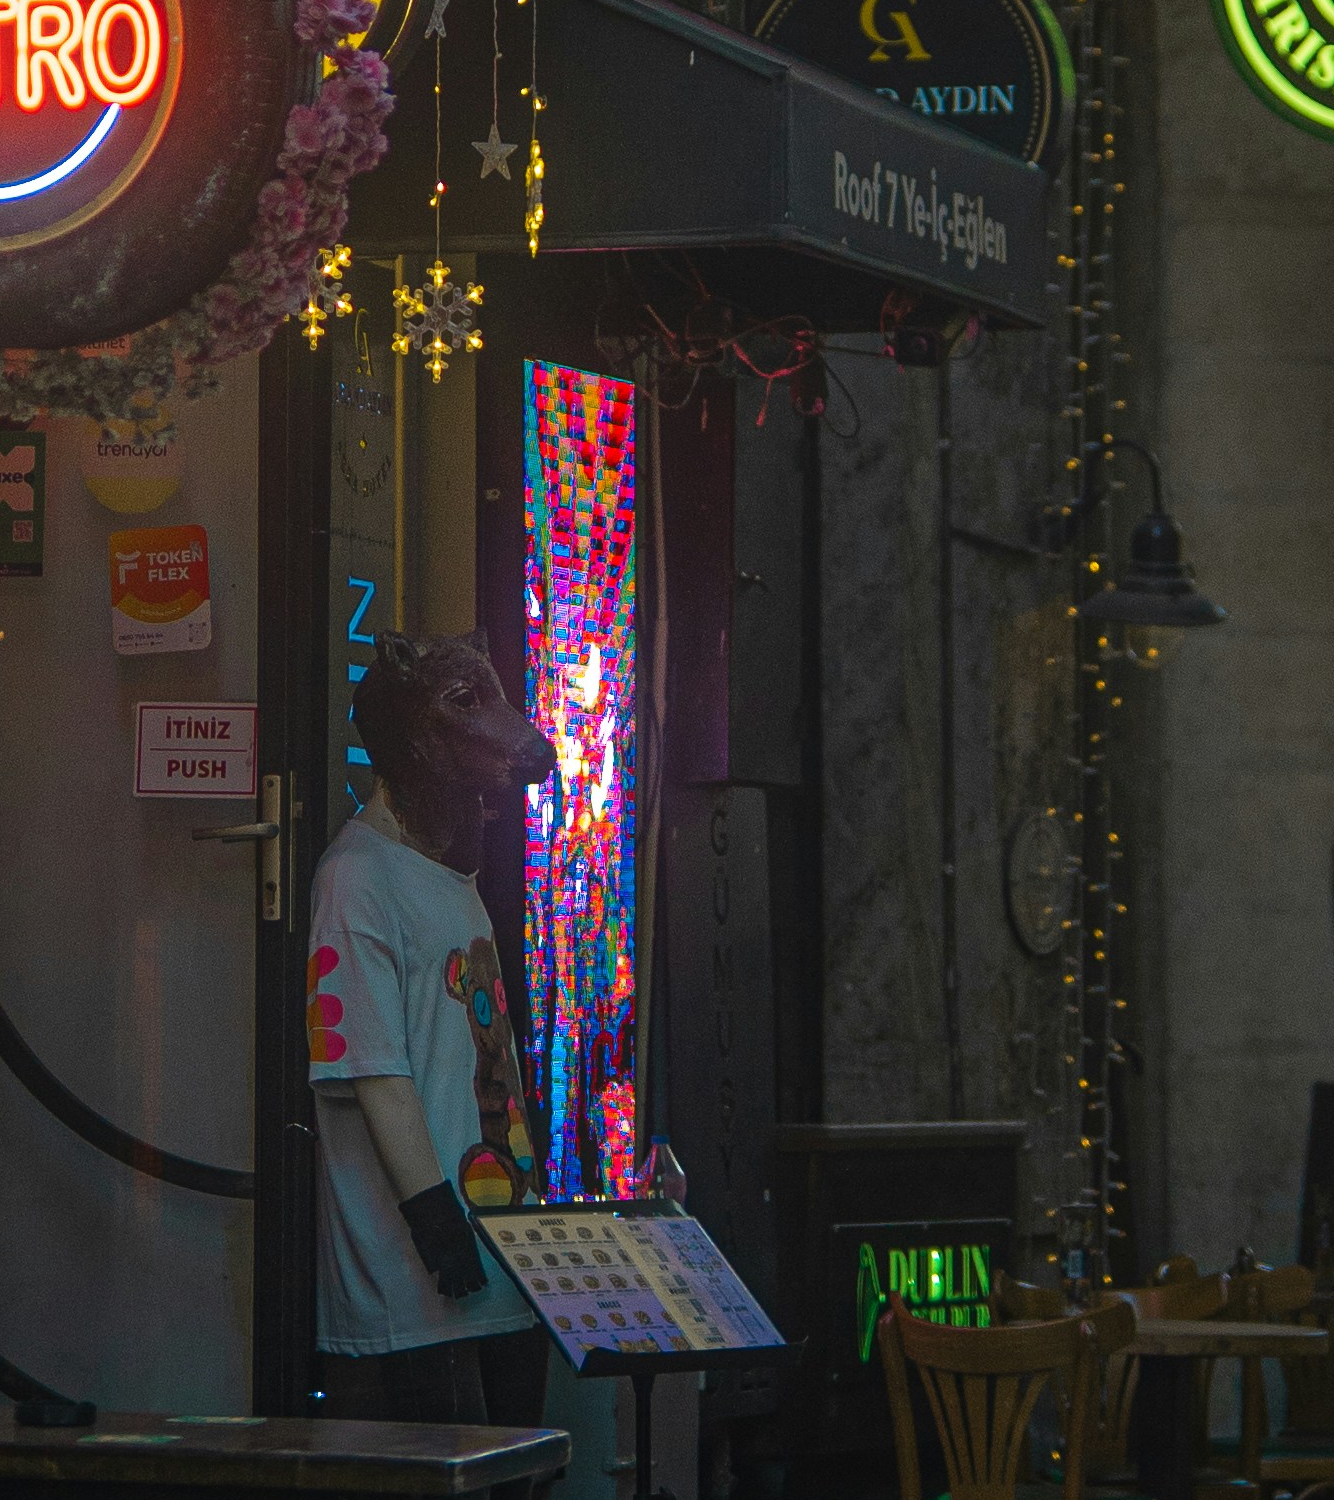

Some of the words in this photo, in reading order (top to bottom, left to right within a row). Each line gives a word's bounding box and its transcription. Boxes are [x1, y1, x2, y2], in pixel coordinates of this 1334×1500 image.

[911, 84, 1016, 116] AYDIN
[834, 150, 882, 224] Roof
[885, 170, 898, 228] 7
[146, 550, 204, 566] TOKEN
[148, 567, 190, 582] FLEX
[166, 716, 230, 740] İTİNİZ
[167, 760, 226, 779] PUSH
[888, 1244, 990, 1304] DUBLIN
